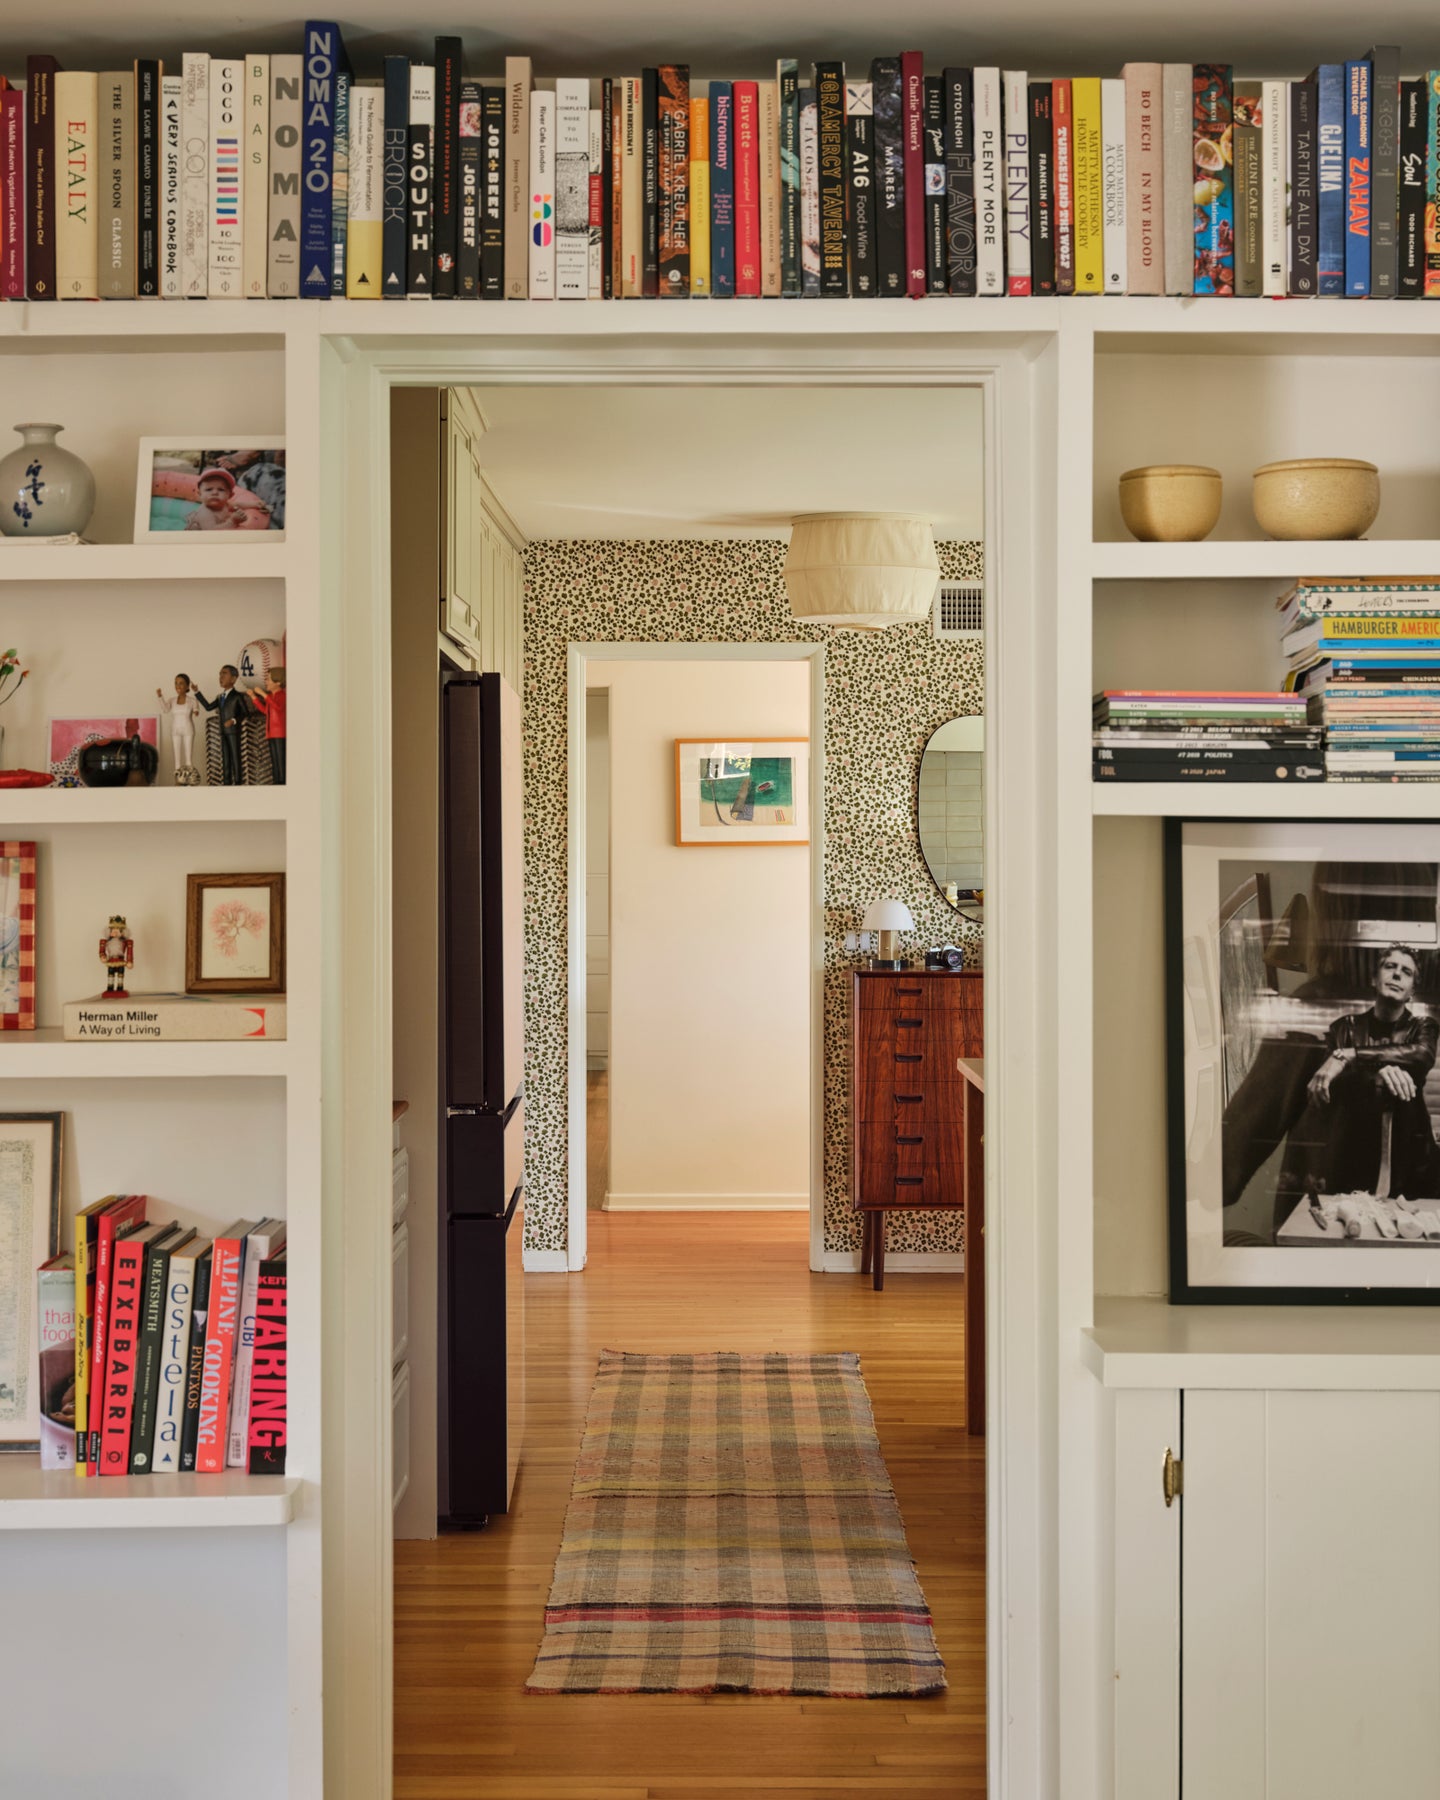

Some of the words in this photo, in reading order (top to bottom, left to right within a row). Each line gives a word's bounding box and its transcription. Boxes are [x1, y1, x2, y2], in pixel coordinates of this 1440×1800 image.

[113, 84, 122, 110] THE
[222, 67, 232, 123] COCO
[308, 31, 332, 127] NOMA
[337, 76, 347, 106] NOMA
[910, 75, 920, 110] Charlie
[1211, 91, 1217, 101] BO
[8, 106, 16, 118] The
[144, 109, 150, 119] LA
[168, 100, 177, 109] A
[252, 66, 262, 164] BRAS
[337, 110, 346, 121] IN
[512, 83, 522, 135] Wildness
[953, 83, 963, 148] OTTOLENGHI
[1141, 90, 1151, 109] BO
[1271, 89, 1279, 112] CHEZ
[8, 120, 16, 144] Middle
[113, 118, 122, 160] SILVER
[167, 114, 178, 147] VERY
[674, 110, 686, 169] GABRIEL
[715, 95, 730, 170] bistronomy
[740, 95, 752, 148] Buvette
[820, 81, 842, 178] GRAMERCY
[911, 112, 921, 151] Trotter's
[1077, 118, 1087, 153] HOME
[1142, 115, 1151, 152] BECH
[1271, 113, 1279, 144] PANISSE
[8, 144, 16, 170] Eastern
[186, 138, 206, 178] COI
[272, 77, 299, 242] NOMA
[337, 124, 346, 162] KYOTO
[488, 124, 499, 158] JOE
[627, 148, 633, 156] LA
[664, 154, 670, 165] OF
[1057, 126, 1069, 183] TURKEY
[1089, 130, 1099, 171] MATTY
[1106, 144, 1116, 152] A
[1116, 144, 1124, 175] MATTY
[1320, 124, 1342, 192] GJELINA
[68, 120, 87, 224] EATALY
[167, 153, 177, 203] SERIOUS
[306, 138, 329, 192] 2.0
[384, 129, 405, 223] BROCK
[464, 164, 475, 195] JOE
[512, 159, 520, 183] Jeremy
[647, 156, 654, 167] DU
[853, 151, 869, 188] A16
[885, 146, 895, 208] MANRESA
[982, 130, 994, 192] PLENTY
[1039, 153, 1047, 200] FRANKLIN
[1078, 156, 1087, 191] STYLE
[1142, 172, 1151, 188] IN
[1250, 153, 1258, 184] ZUNI
[1298, 130, 1310, 197] TARTINE
[1402, 153, 1422, 186] Soul
[7, 171, 16, 208] Vegetarian
[113, 168, 122, 208] SPOON
[410, 143, 428, 250] SOUTH
[488, 172, 499, 219] BEEF
[789, 195, 794, 203] OF
[1007, 134, 1028, 240] PLENTY
[1059, 183, 1069, 208] AND
[1090, 173, 1099, 236] MATHESON
[1106, 156, 1116, 226] COOKBOOK
[1142, 193, 1152, 214] MY
[1250, 188, 1258, 219] CAFE
[1349, 157, 1369, 236] ZAHAV
[464, 206, 475, 247] BEEF
[674, 175, 686, 248] KREUTHER
[823, 185, 844, 254] TAVERN
[947, 153, 975, 277] FLAVOR
[984, 200, 995, 245] MORE
[1040, 210, 1048, 239] STEAK
[1060, 210, 1070, 233] THE
[1079, 195, 1088, 248] COOKERY
[1298, 202, 1310, 229] ALL
[112, 217, 122, 269] CLASSIC
[166, 210, 177, 274] COOKBOOK
[1060, 234, 1070, 269] WOLF
[1142, 220, 1152, 267] BLOOD
[1298, 235, 1310, 265] DAY
[334, 279, 343, 290] 01
[1333, 622, 1398, 635] HAMBURGER
[1098, 750, 1114, 759] FOOL
[1100, 766, 1116, 776] FOOL
[79, 1012, 124, 1022] Herman
[126, 1011, 158, 1021] Miller
[79, 1025, 87, 1034] A
[90, 1025, 113, 1036] Way
[114, 1025, 125, 1034] of
[129, 1025, 160, 1036] Living
[147, 1258, 163, 1332] MEATSMITH
[217, 1250, 239, 1336] ALPINE
[45, 1308, 75, 1324] thai
[242, 1316, 256, 1347] CIBI
[108, 1258, 136, 1434] ETXEBARRI
[160, 1283, 189, 1442] estela
[188, 1345, 203, 1409] PINTXOS
[249, 1288, 287, 1447] HARING
[198, 1338, 223, 1444] COOKING
